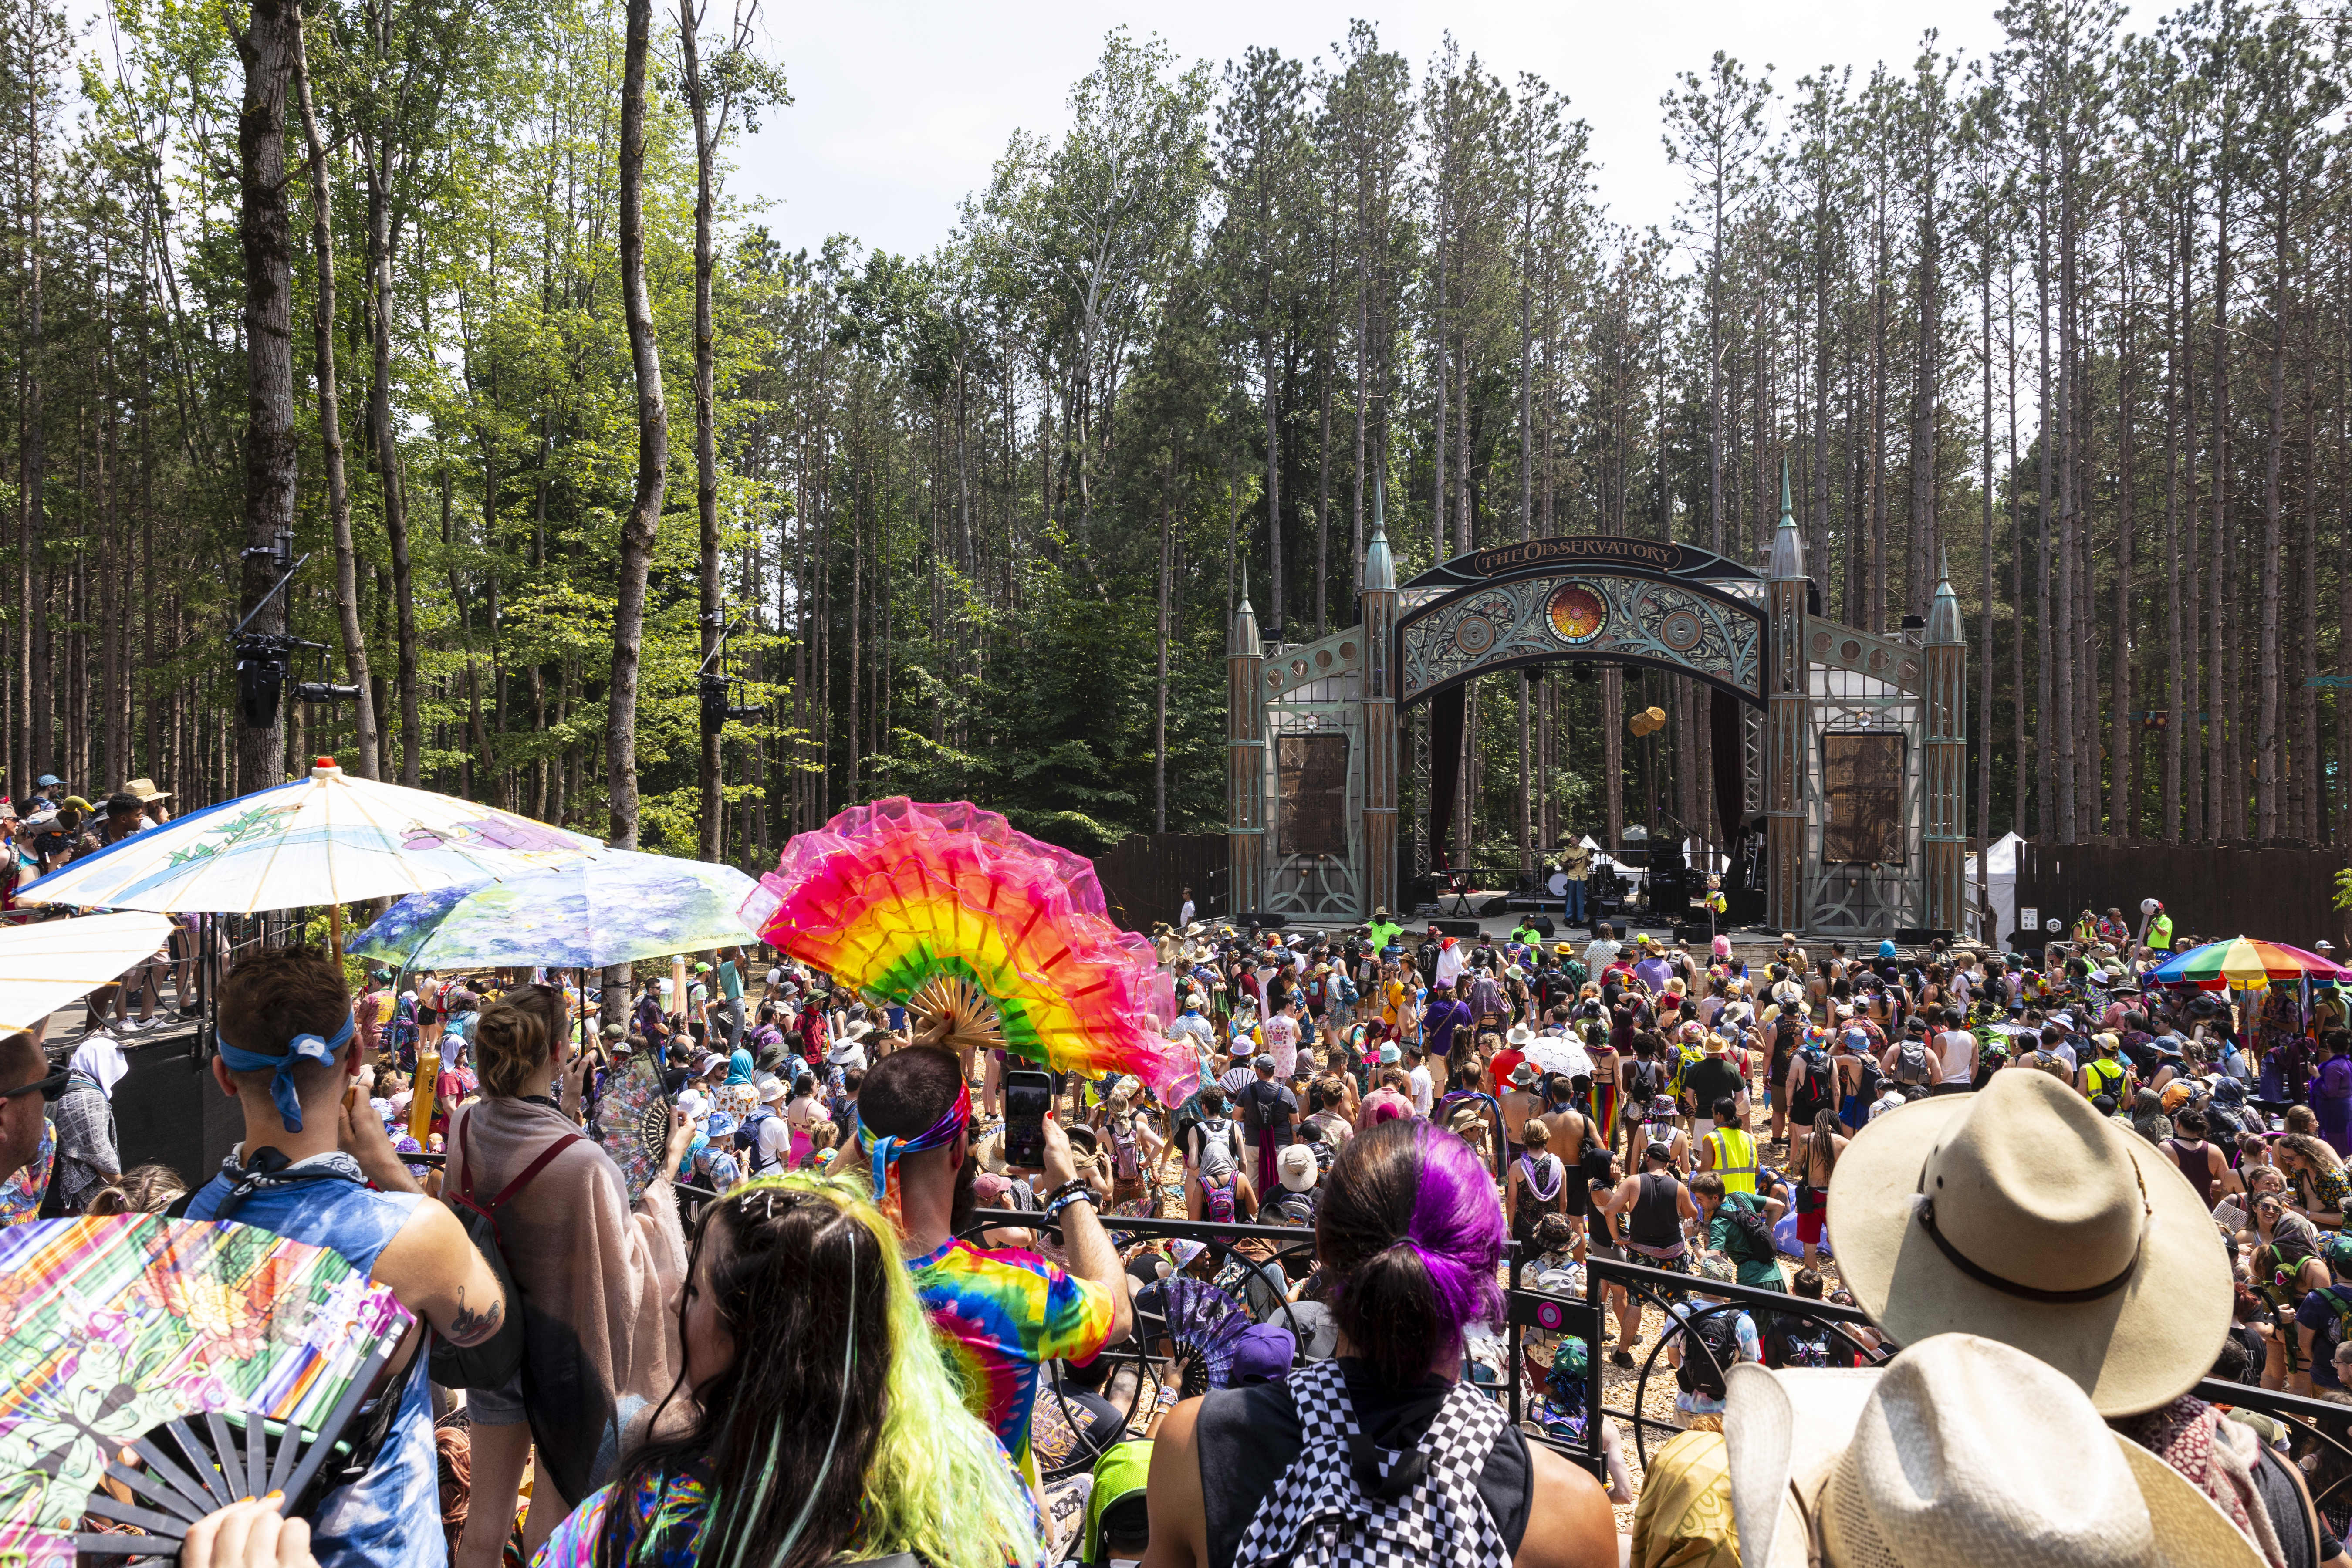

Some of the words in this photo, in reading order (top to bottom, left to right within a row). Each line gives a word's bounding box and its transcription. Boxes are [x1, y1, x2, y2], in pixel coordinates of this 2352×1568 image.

[1482, 548, 1527, 569] THE
[1524, 541, 1672, 563] OBSERVATORY
[1547, 585, 1572, 611] ELECTRIC
[1584, 585, 1605, 607] FOREST
[1548, 621, 1569, 642] FOREST
[1581, 615, 1606, 642] ELECTRIC
